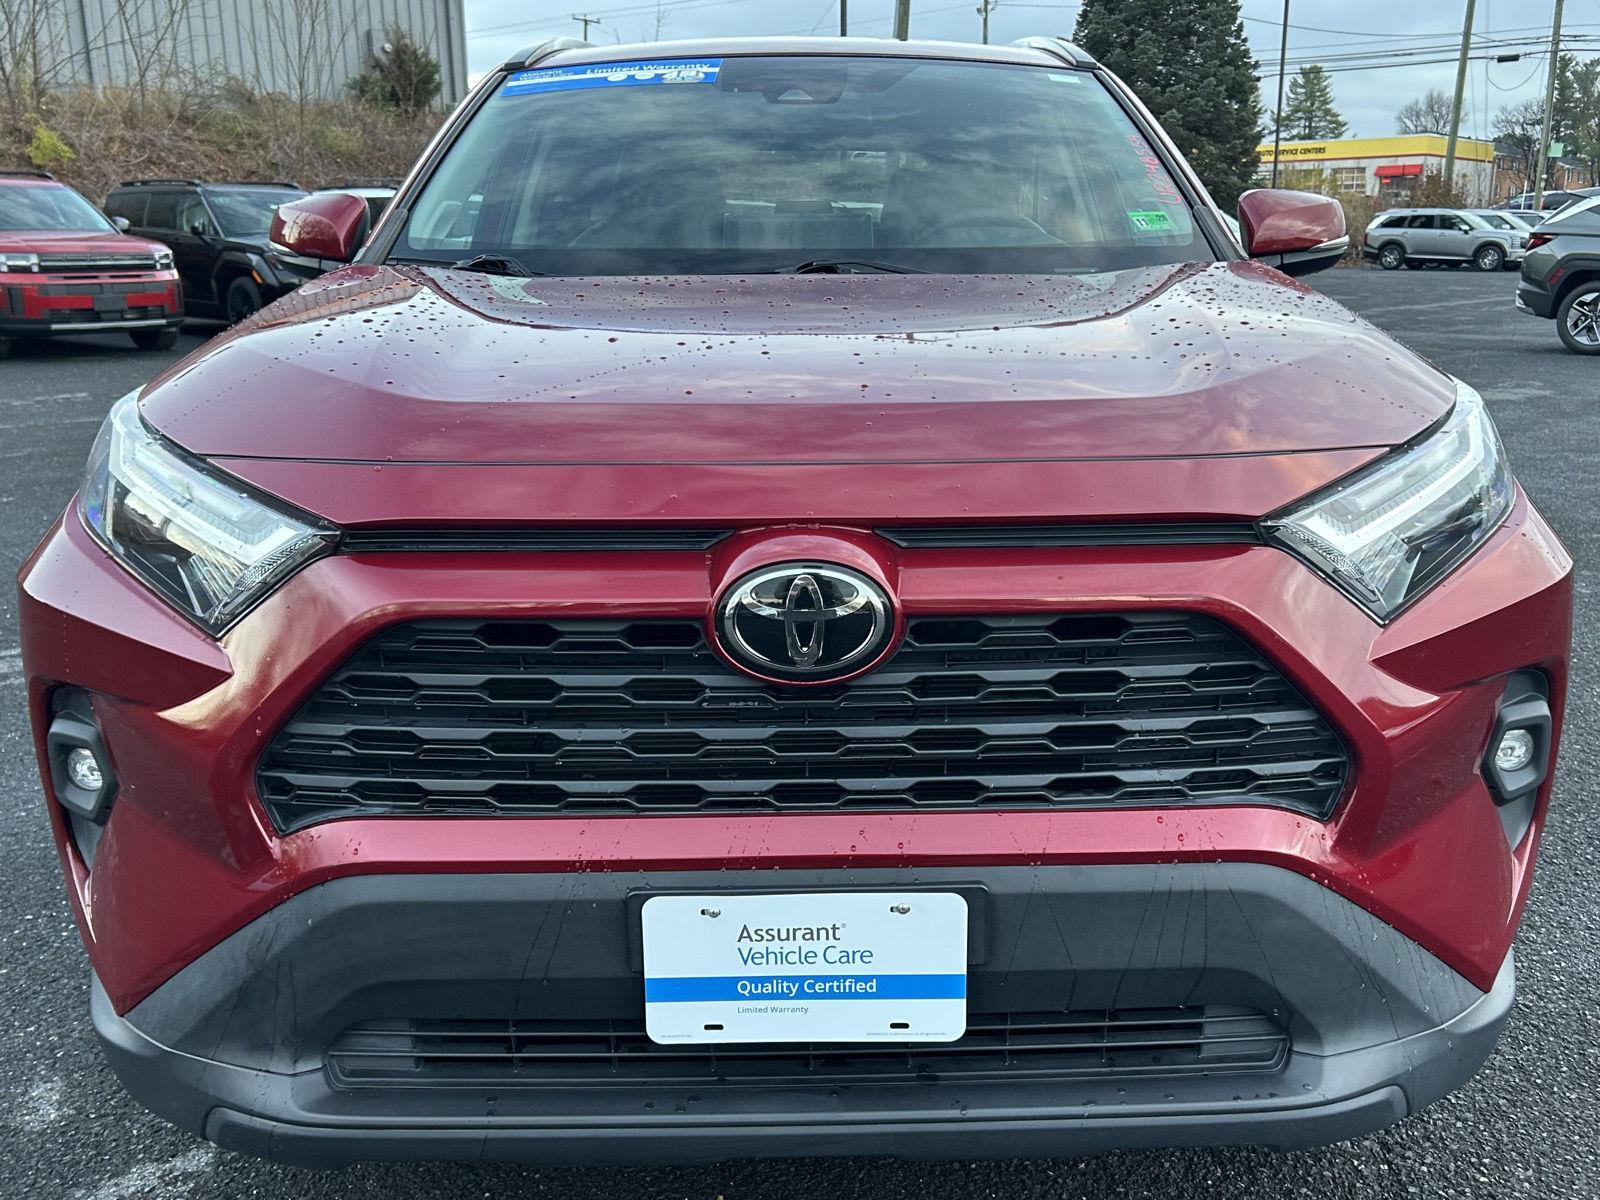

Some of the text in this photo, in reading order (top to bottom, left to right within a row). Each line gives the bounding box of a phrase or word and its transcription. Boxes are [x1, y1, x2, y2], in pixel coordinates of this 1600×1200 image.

[586, 63, 711, 75] Limited Warranty
[1299, 147, 1326, 155] CENTERS
[1136, 218, 1149, 226] 11
[737, 923, 841, 943] Assurant
[738, 945, 874, 966] Vehicle Care
[737, 979, 877, 998] Quality Certified
[770, 1006, 809, 1015] Warranty
